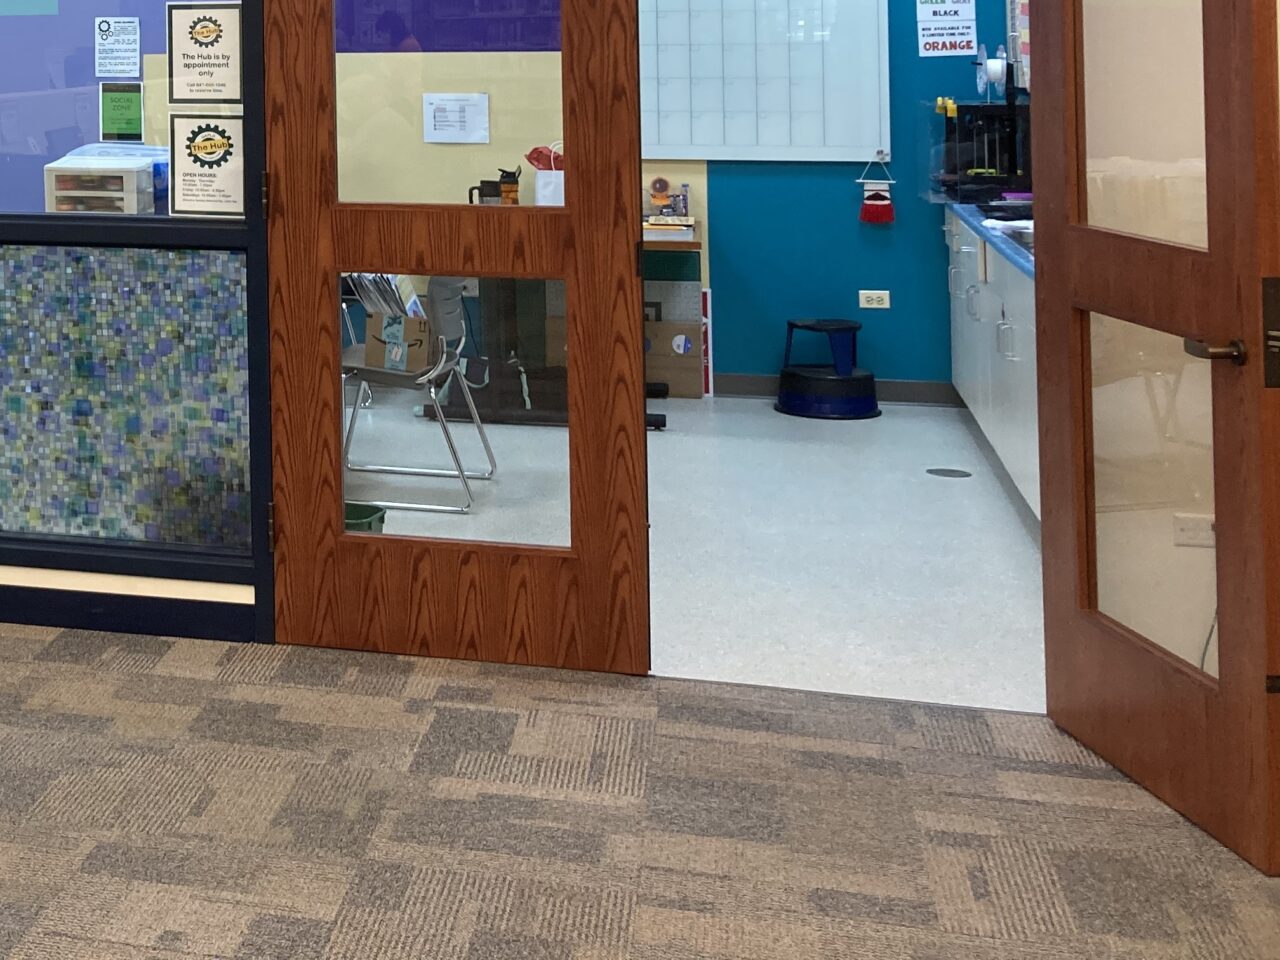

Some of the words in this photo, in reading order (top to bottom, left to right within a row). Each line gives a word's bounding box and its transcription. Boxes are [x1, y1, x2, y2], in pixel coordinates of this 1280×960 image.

[923, 40, 973, 51] ORANGE
[221, 53, 231, 61] by
[198, 70, 214, 78] only
[210, 142, 228, 150] Hub
